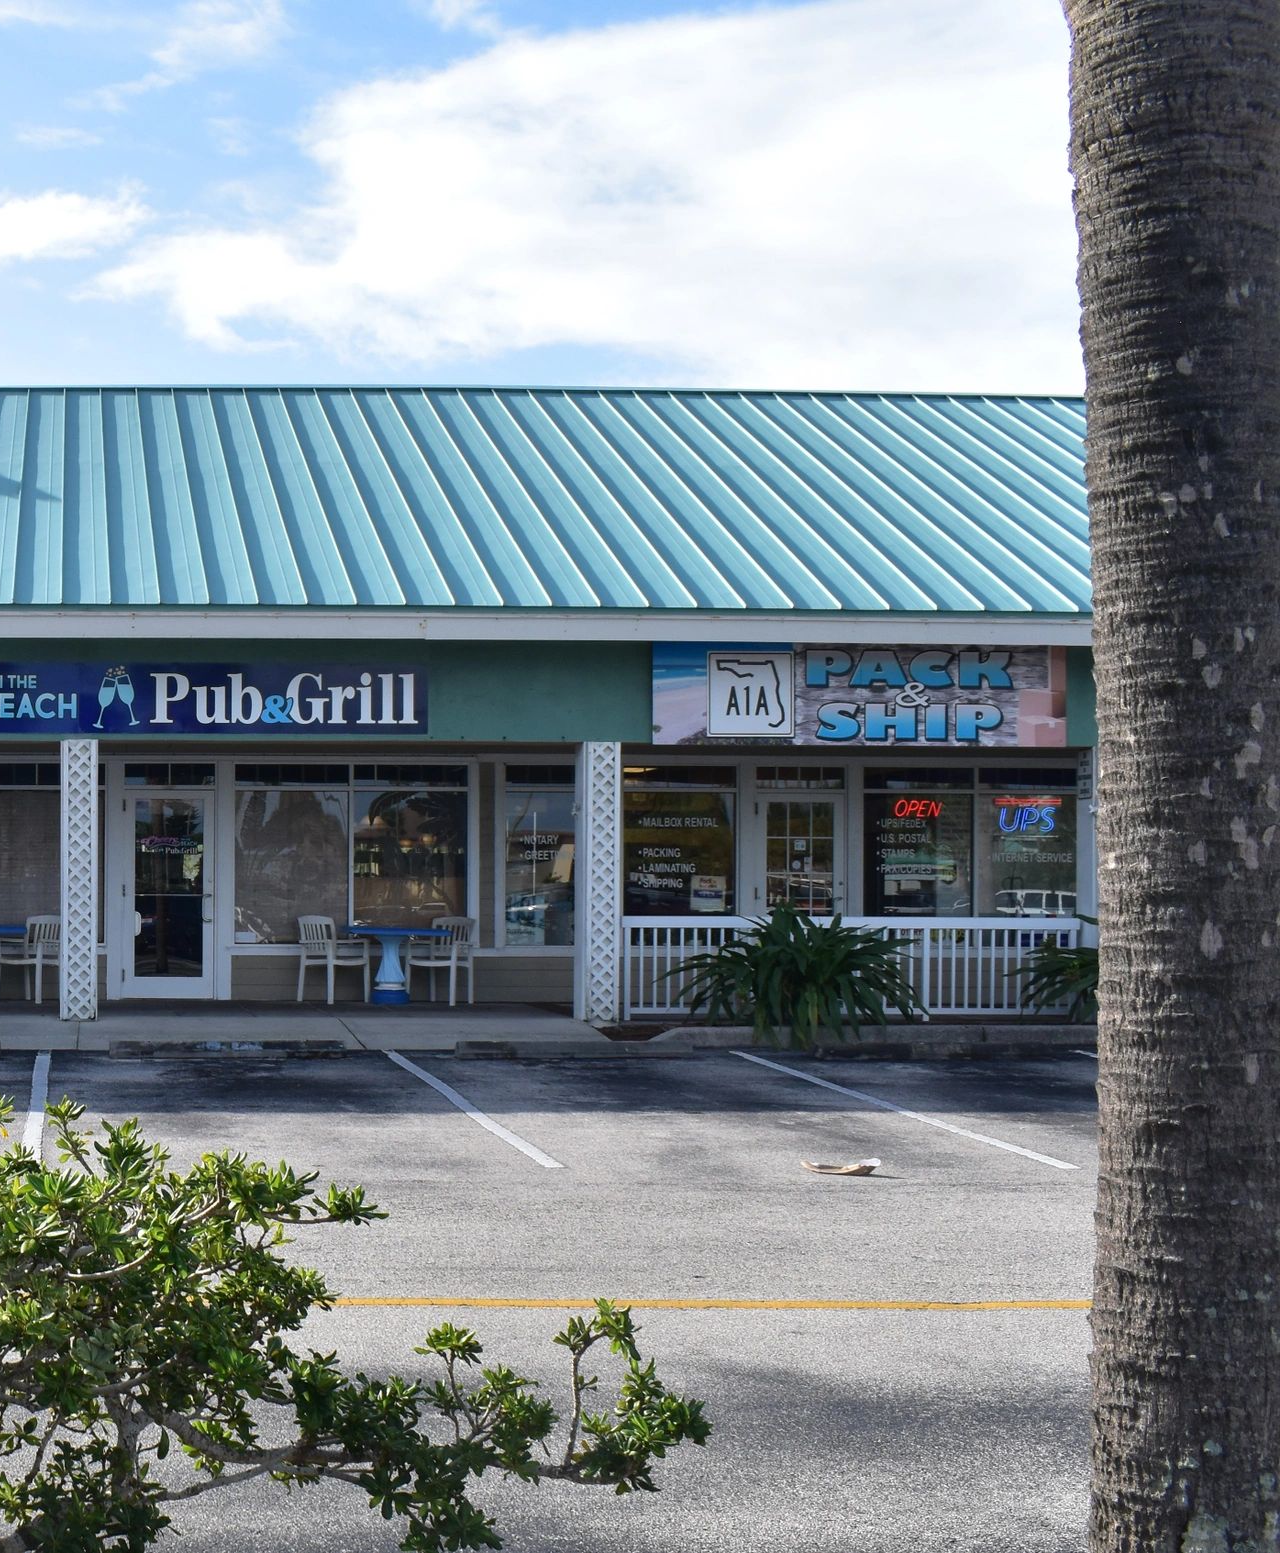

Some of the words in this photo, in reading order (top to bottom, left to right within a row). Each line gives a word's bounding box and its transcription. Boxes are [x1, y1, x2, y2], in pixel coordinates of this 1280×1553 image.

[805, 649, 1013, 690] PACK
[7, 675, 37, 689] THE
[726, 686, 770, 716] A1A
[816, 702, 1004, 743] SHIP
[893, 799, 944, 819] OPEN
[642, 817, 682, 828] MAILBOX
[685, 817, 719, 828] RENTAL
[998, 806, 1058, 833] UPS
[524, 835, 559, 845] NOTARY
[881, 833, 897, 844] U.S.
[899, 833, 932, 844] POSTAL
[642, 848, 681, 858] PACKING
[881, 849, 916, 859] STAMPS
[992, 853, 1035, 864] INTERNET
[1037, 853, 1073, 864] SERVICE
[642, 863, 696, 873] LAMINATING
[642, 878, 684, 889] SHIPPING
